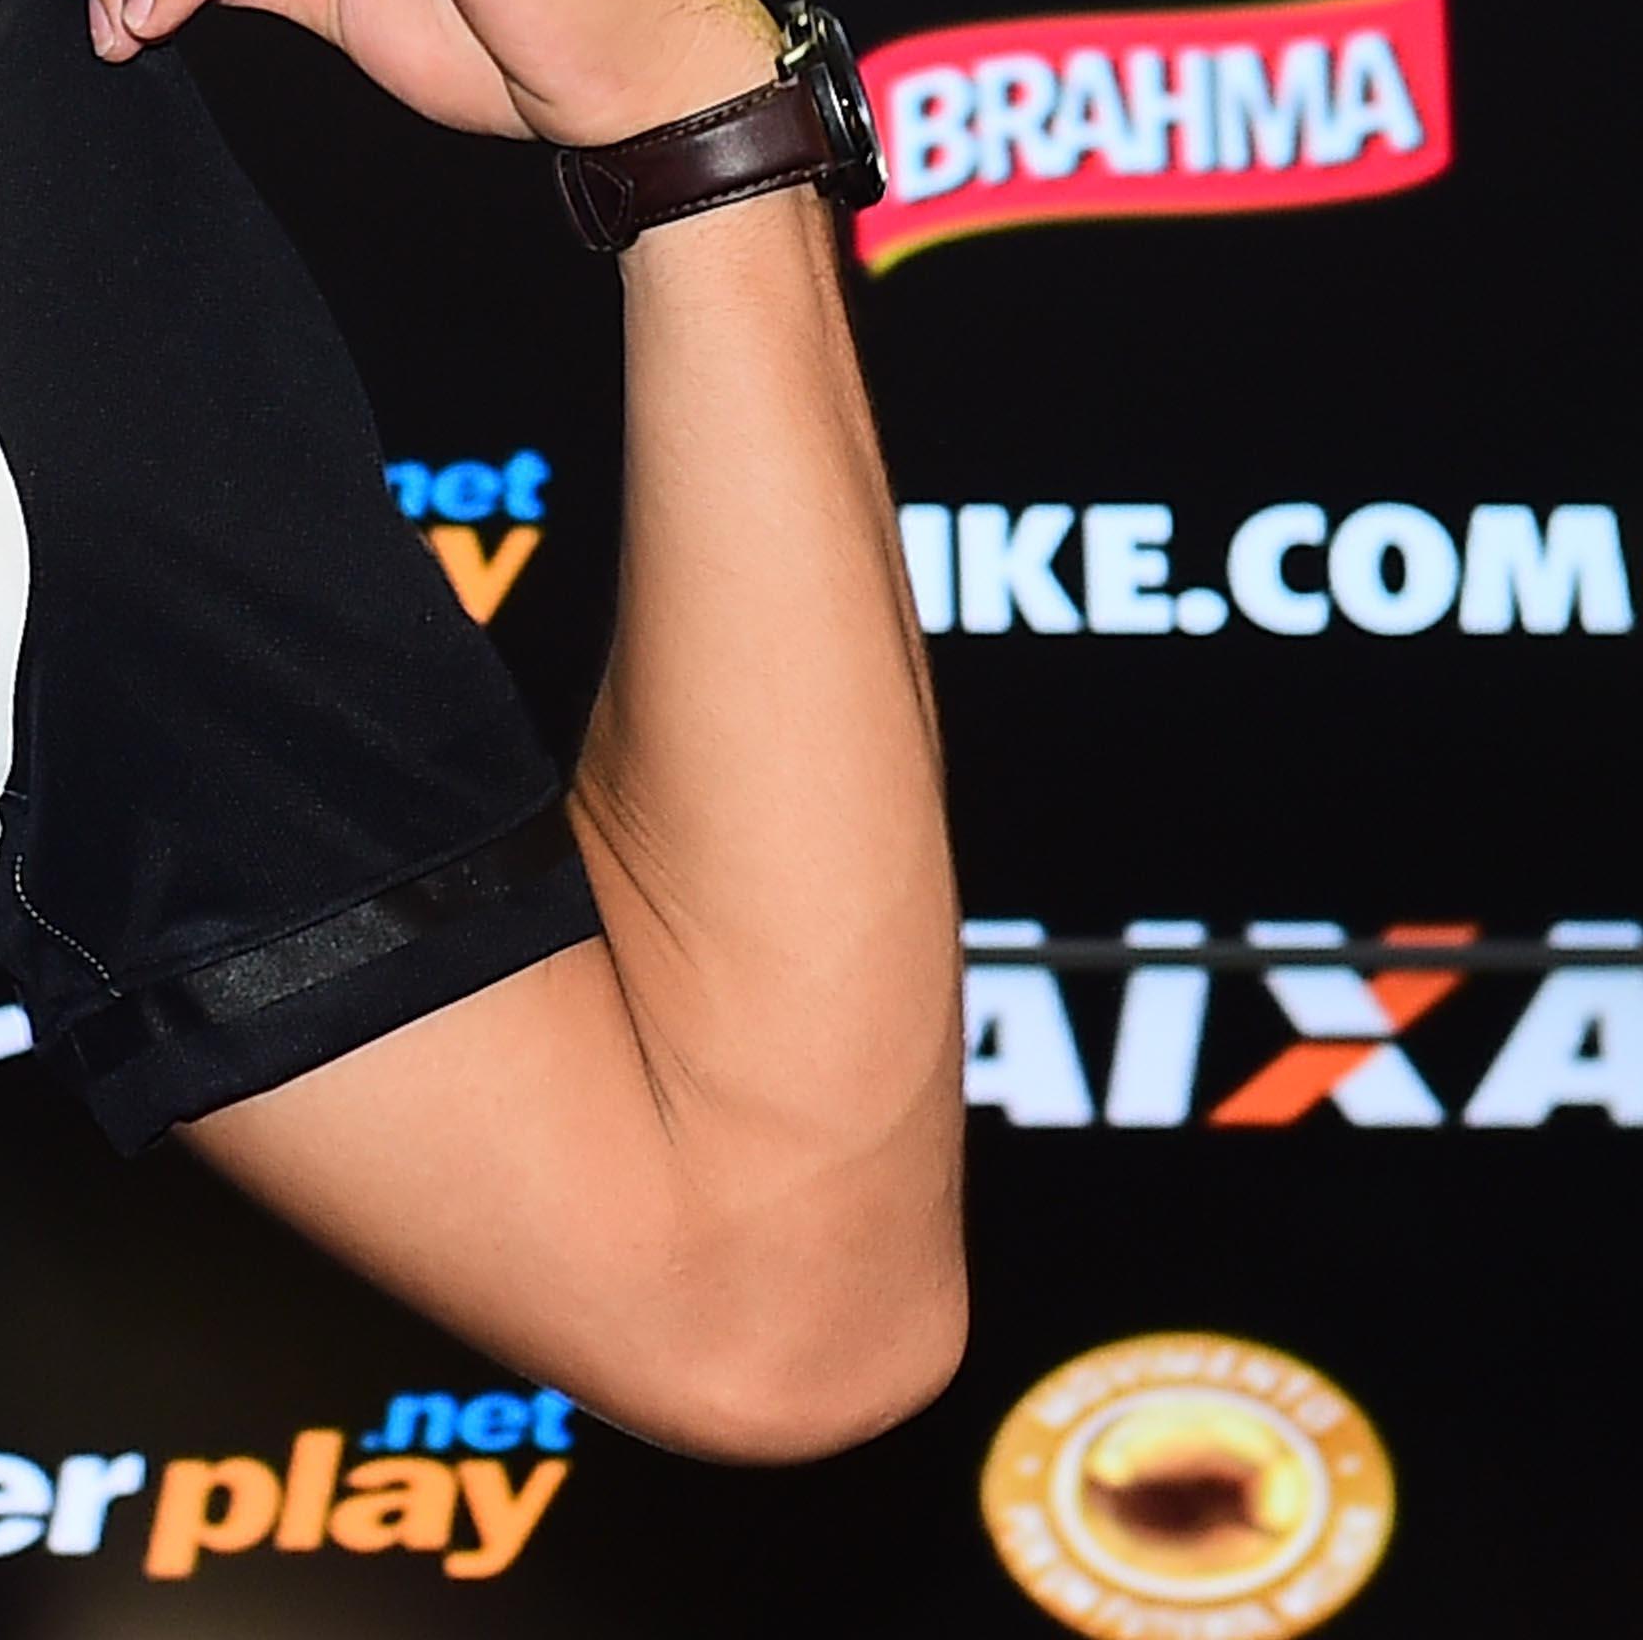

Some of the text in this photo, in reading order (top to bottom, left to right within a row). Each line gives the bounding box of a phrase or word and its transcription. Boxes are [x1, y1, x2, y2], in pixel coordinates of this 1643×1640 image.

[887, 30, 1426, 202] BRAHMA
[899, 503, 1632, 636] IKE.COM
[961, 920, 1643, 1128] AIXA
